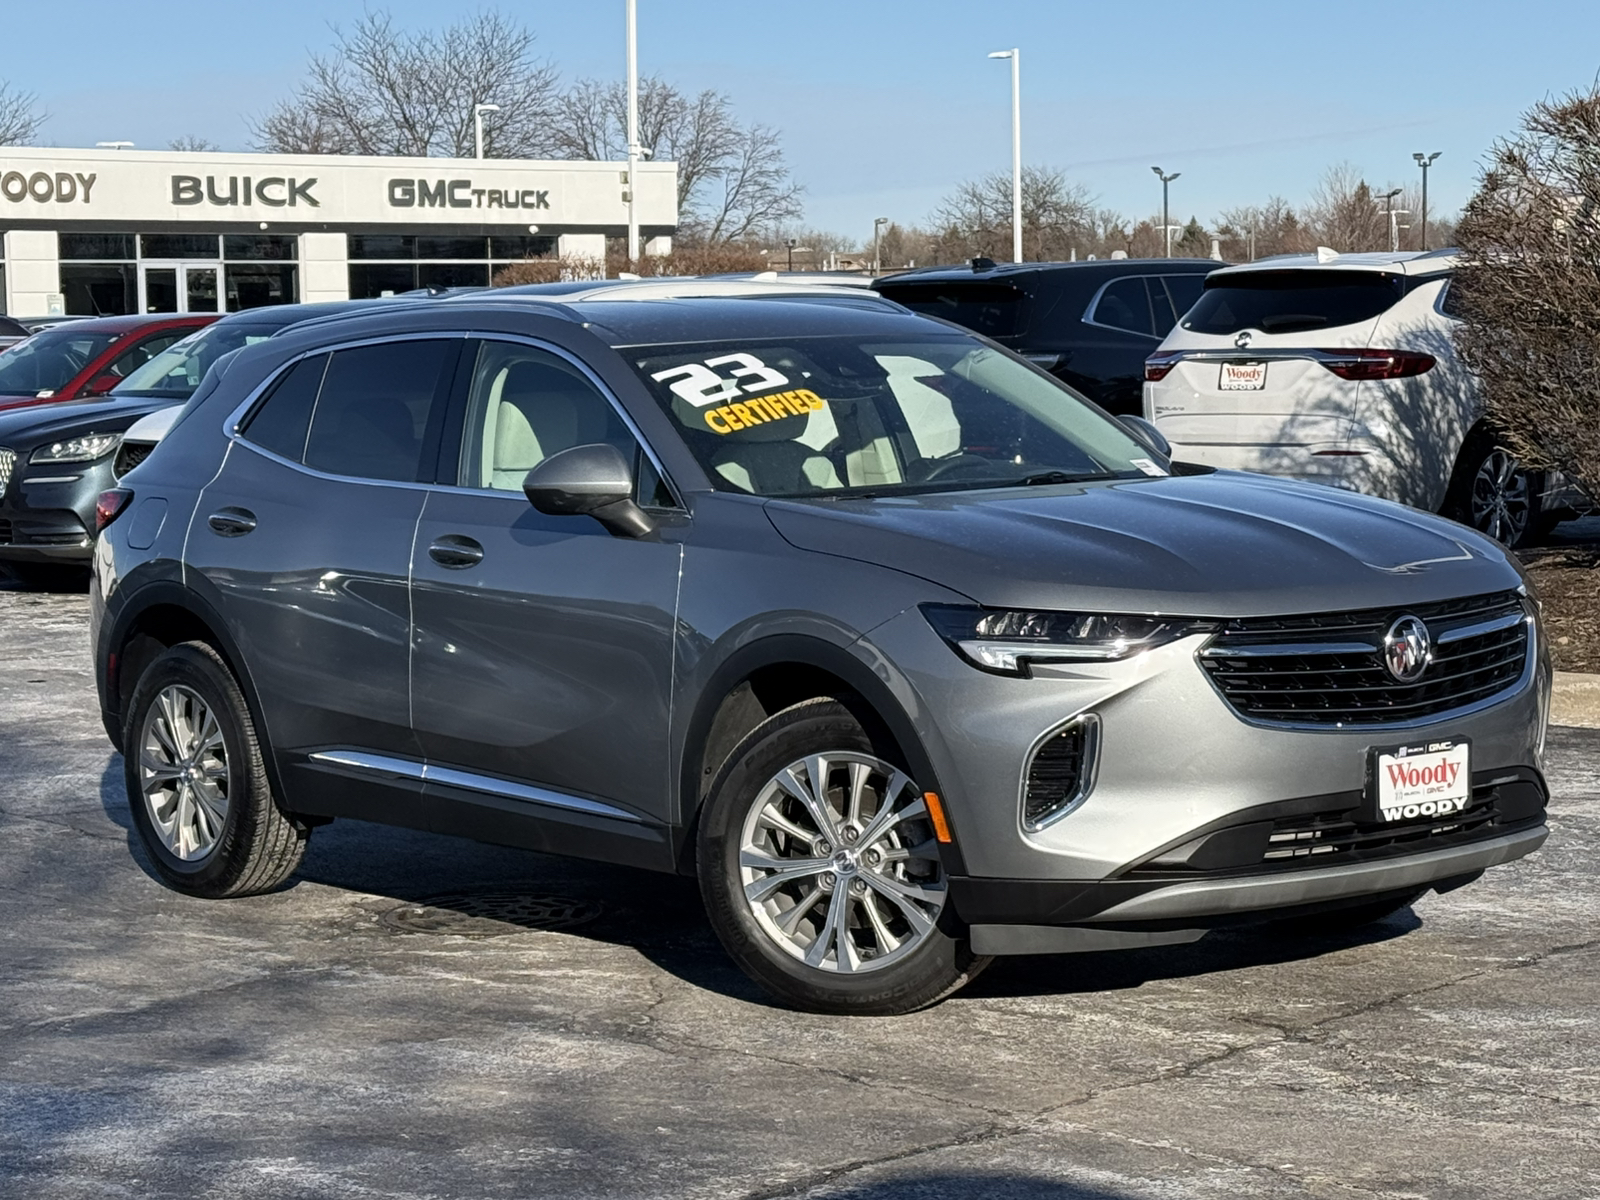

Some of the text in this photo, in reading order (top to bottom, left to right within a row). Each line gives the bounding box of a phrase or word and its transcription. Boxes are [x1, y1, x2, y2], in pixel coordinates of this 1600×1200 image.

[0, 170, 97, 204] OODY
[171, 175, 320, 207] BUICK
[388, 178, 550, 210] GMC TRUCK
[650, 353, 789, 407] 23
[1226, 368, 1263, 381] Woody
[704, 389, 823, 434] CERTIFIED
[1428, 741, 1452, 752] GMC
[1385, 757, 1461, 789] Woody
[1382, 796, 1468, 821] WOODY
